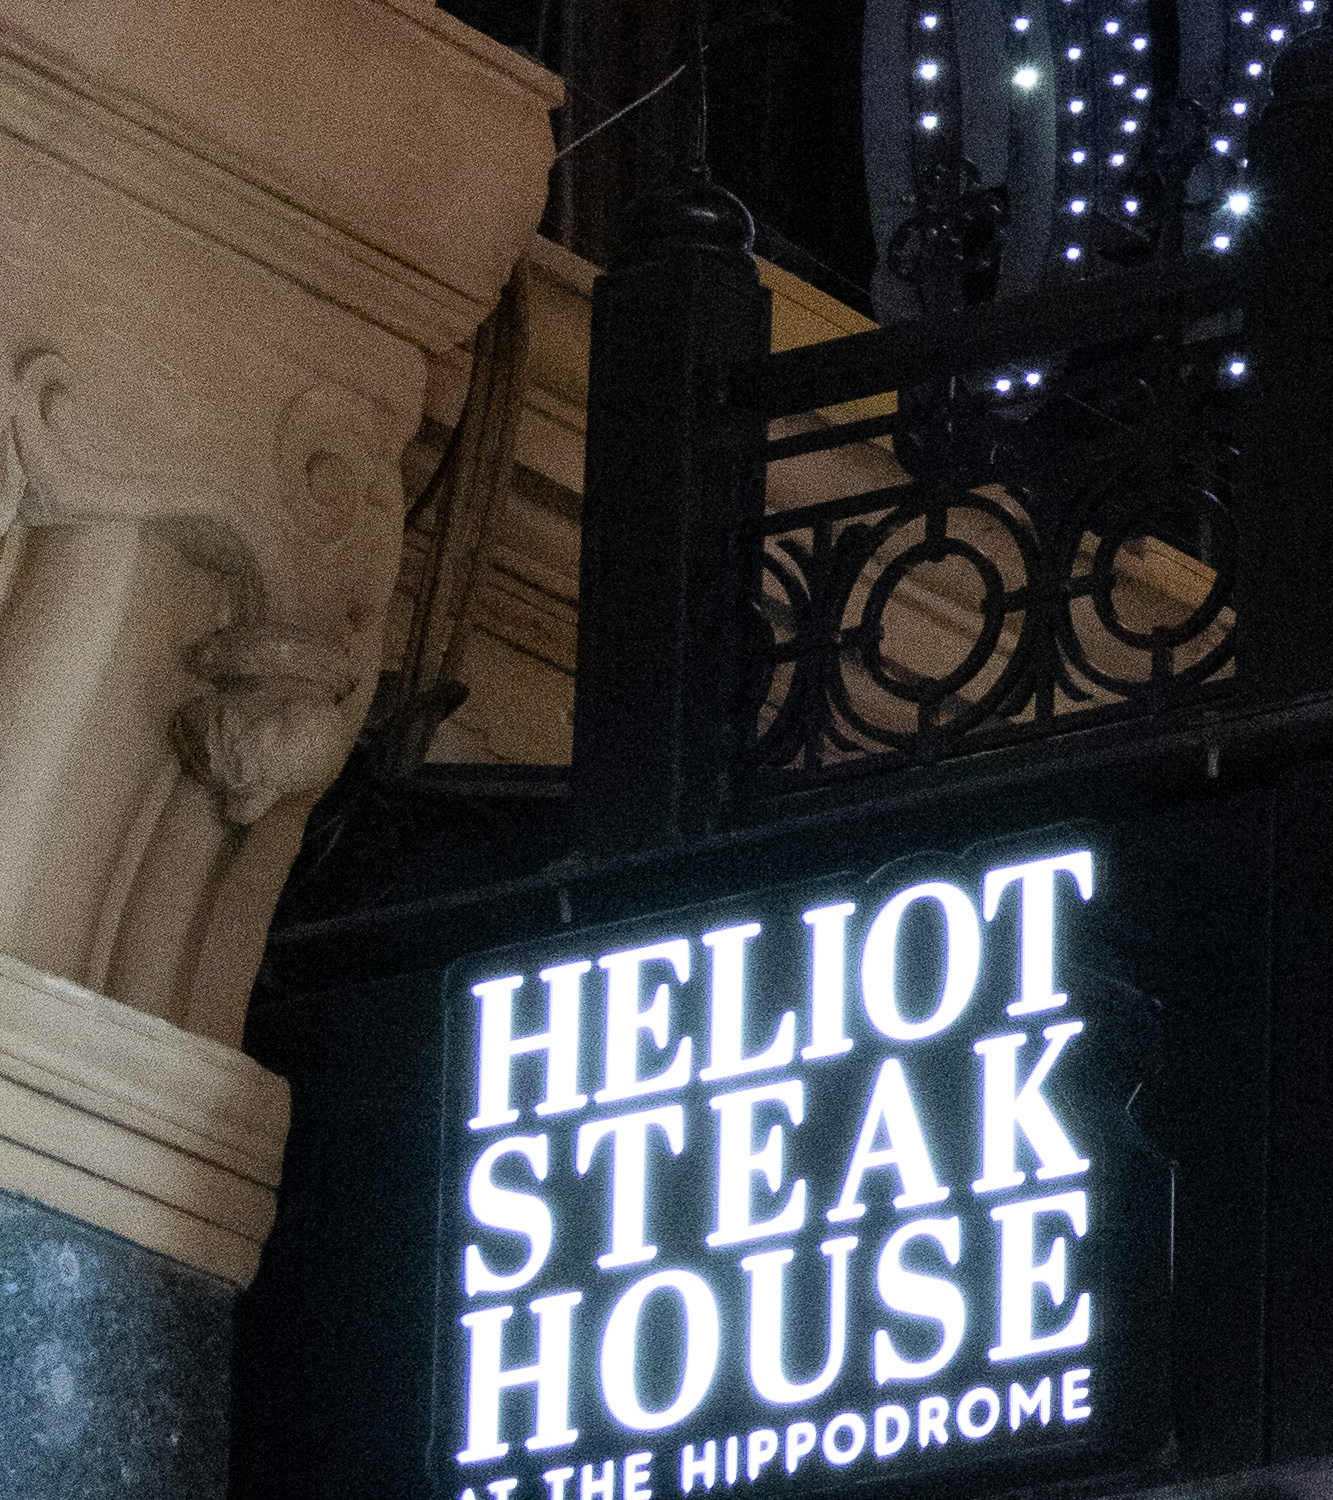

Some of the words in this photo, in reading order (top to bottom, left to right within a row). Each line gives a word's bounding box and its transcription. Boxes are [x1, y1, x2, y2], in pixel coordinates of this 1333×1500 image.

[466, 848, 1095, 1132] HELIOT
[463, 1018, 1092, 1300] STEAK
[455, 1188, 1091, 1466] HOUSE
[680, 1367, 1093, 1494] HIPPODROME
